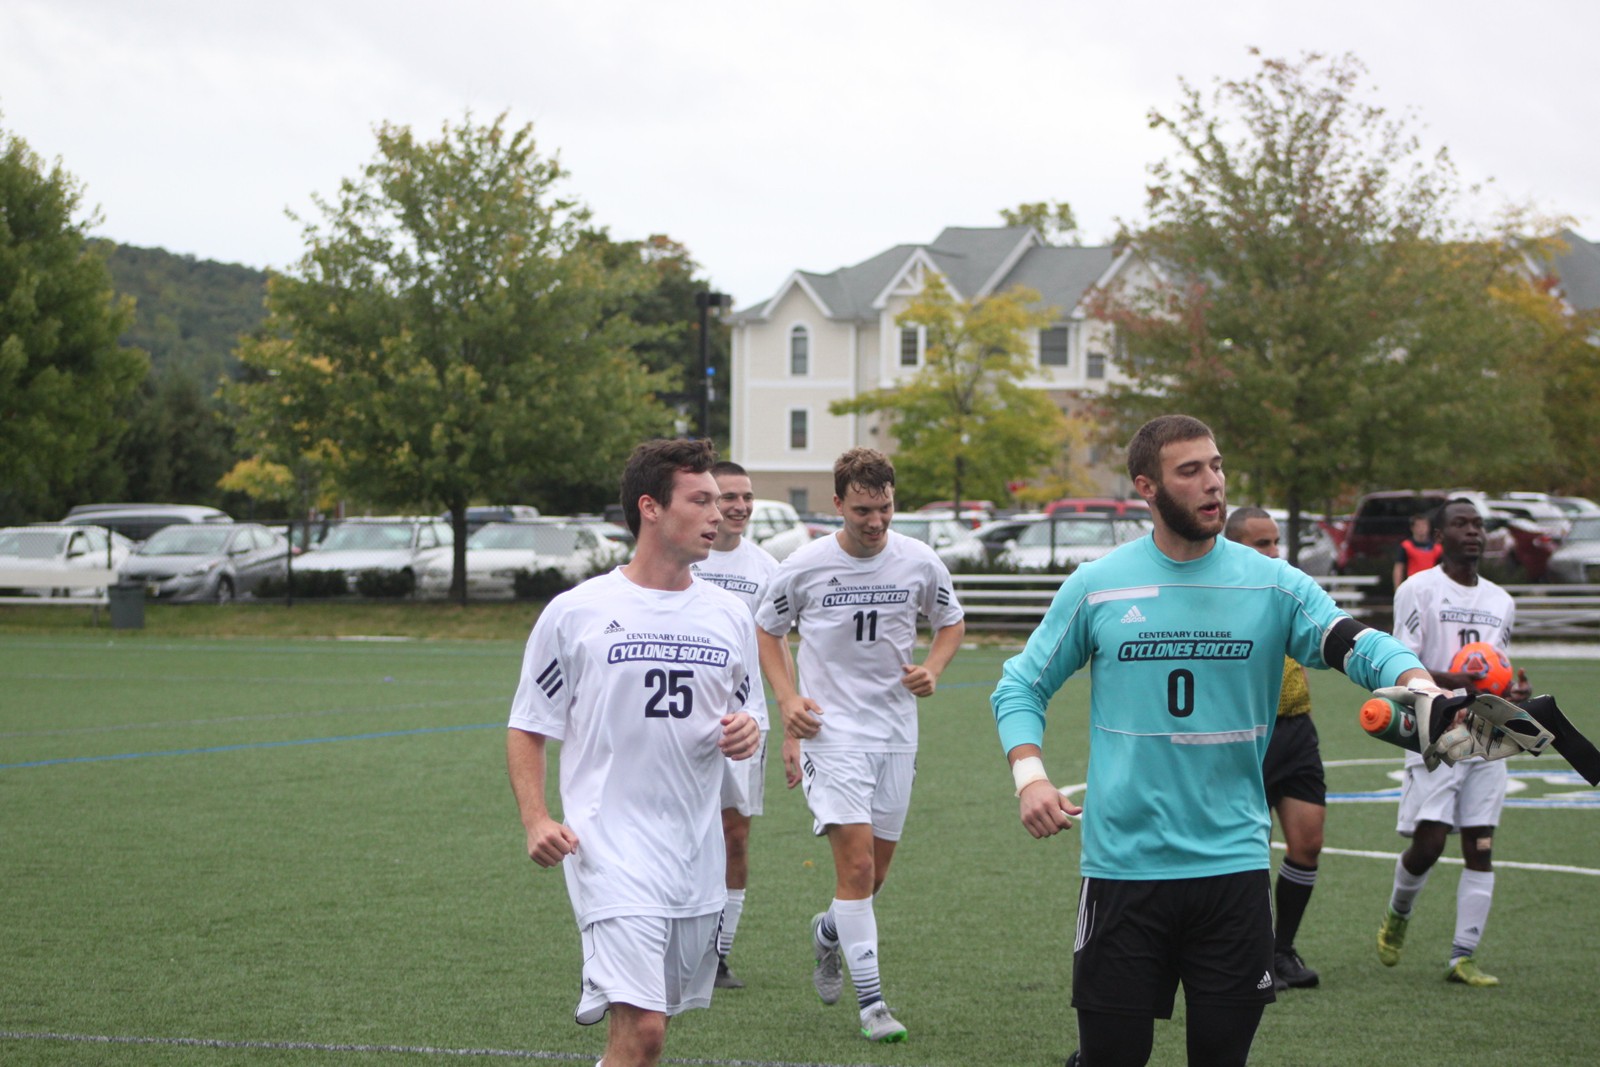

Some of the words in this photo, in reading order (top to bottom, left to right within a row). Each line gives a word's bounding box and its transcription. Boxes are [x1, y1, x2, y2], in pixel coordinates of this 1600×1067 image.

[823, 593, 873, 606] CYCLONES
[872, 591, 908, 603] SOCCER
[853, 610, 877, 641] 11
[1120, 615, 1146, 624] adidas
[604, 626, 625, 635] adidas
[1138, 631, 1192, 639] CENTENARY
[1193, 631, 1232, 639] COLLEGE
[627, 633, 675, 641] CENTENARY
[677, 635, 711, 645] COLLEGE
[610, 644, 677, 662] CYCLONES
[678, 647, 728, 666] SOCCER
[1120, 642, 1194, 659] CYCLONES
[1194, 642, 1252, 658] SOCCER
[644, 668, 694, 719] 25
[1167, 668, 1194, 718] 0
